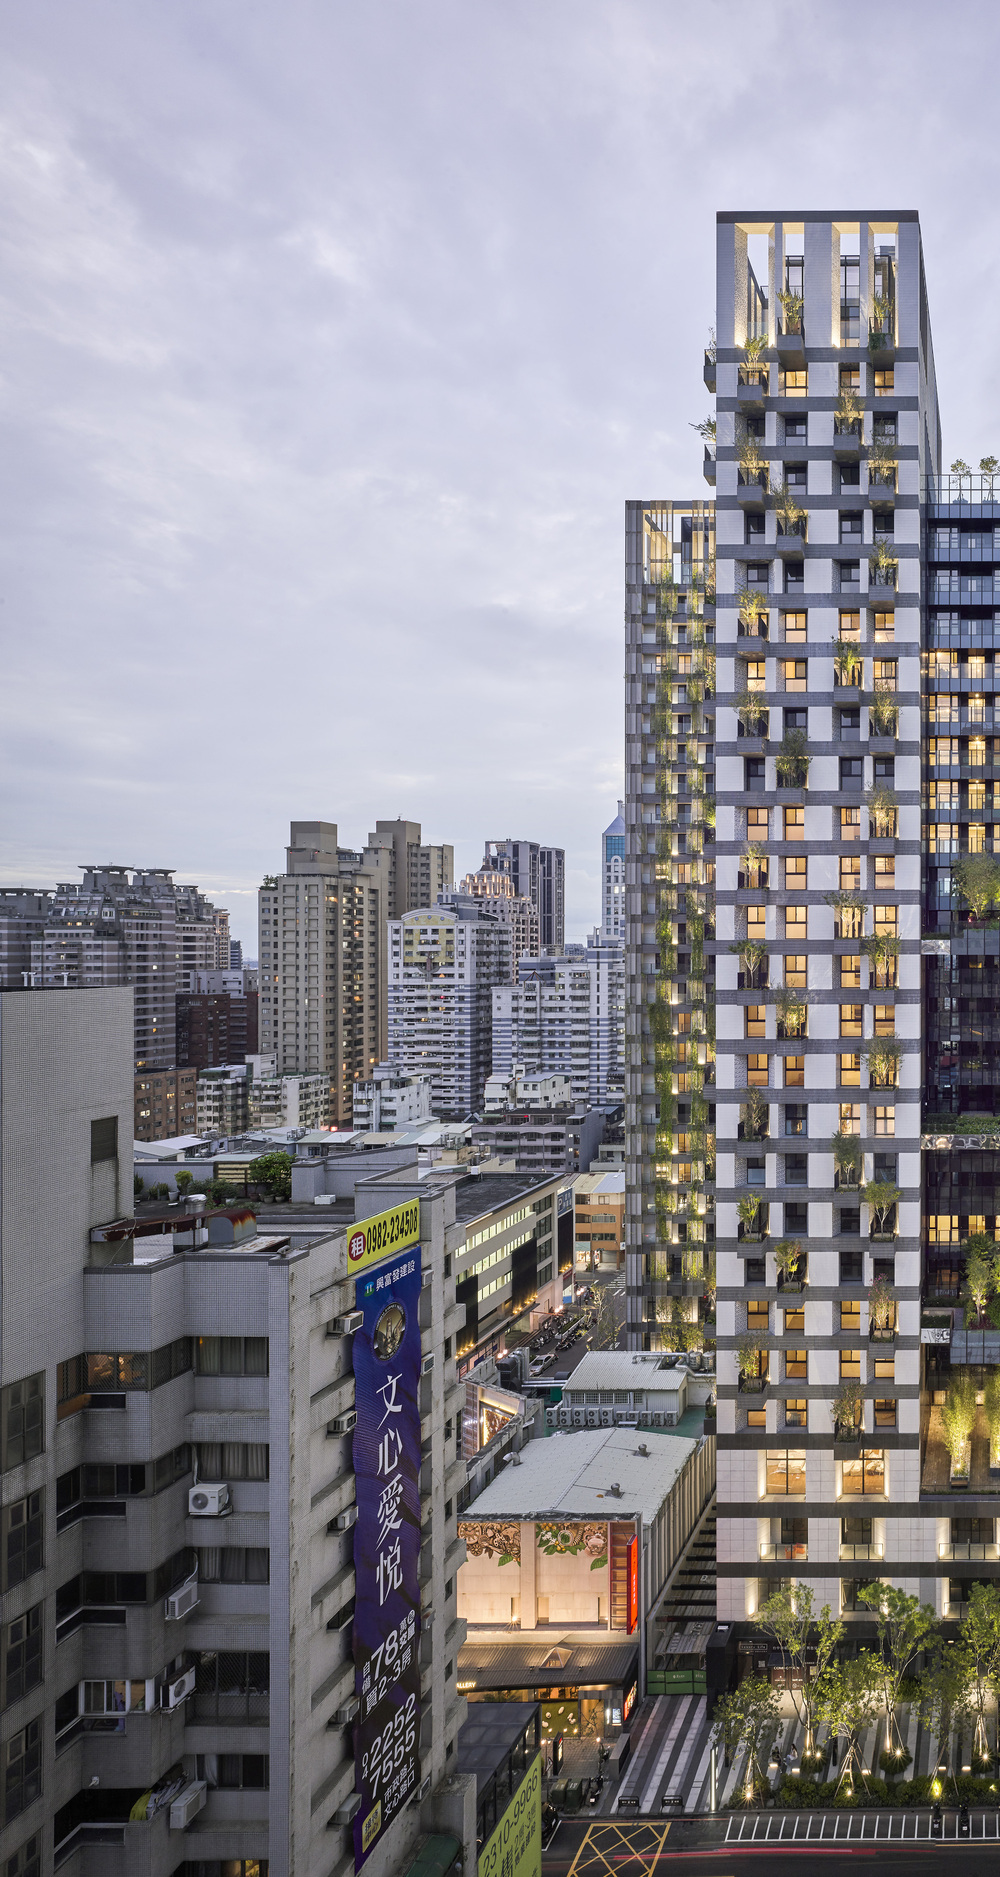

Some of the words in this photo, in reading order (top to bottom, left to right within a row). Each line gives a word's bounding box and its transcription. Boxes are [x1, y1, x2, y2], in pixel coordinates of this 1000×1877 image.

[351, 1235, 364, 1258] 租
[366, 1206, 418, 1255] 0982-234508
[375, 1373, 404, 1607] 文心愛悅
[371, 1629, 399, 1681] 78
[369, 1721, 416, 1800] 7555
[370, 1692, 416, 1771] 2252
